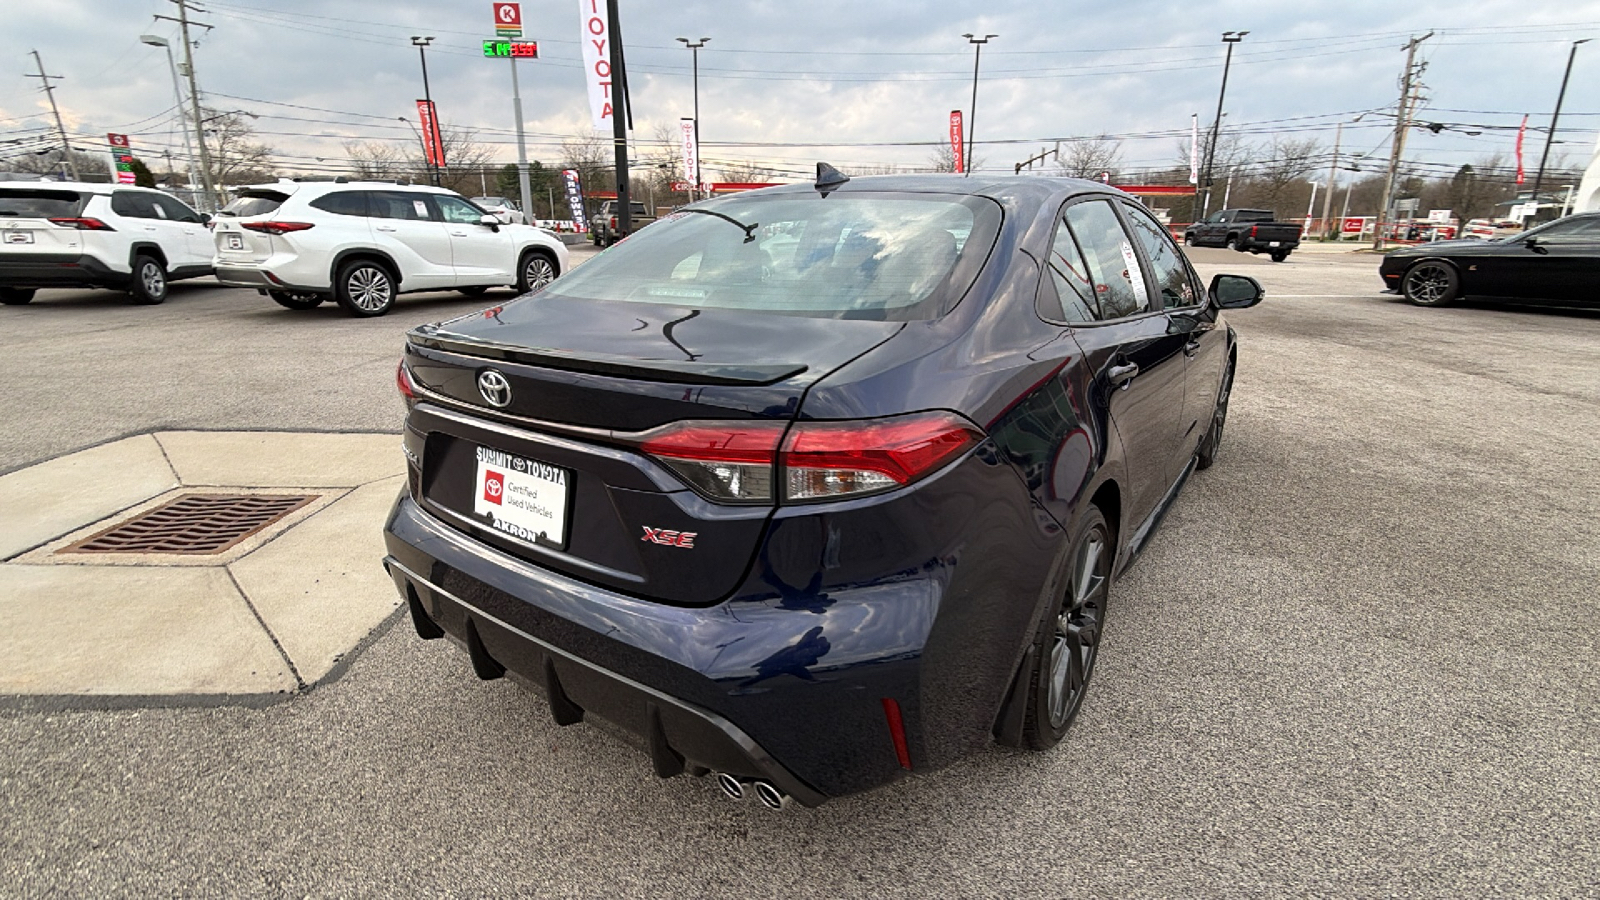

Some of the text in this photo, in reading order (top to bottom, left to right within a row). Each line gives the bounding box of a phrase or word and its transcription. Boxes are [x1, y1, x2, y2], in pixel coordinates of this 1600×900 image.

[685, 134, 694, 180] TOYOTA
[476, 446, 566, 486] SUMMIT TOYOTA
[508, 482, 538, 499] Certified
[507, 495, 553, 519] Used Vehicles
[493, 518, 536, 542] AKRON
[640, 525, 698, 549] XSE
